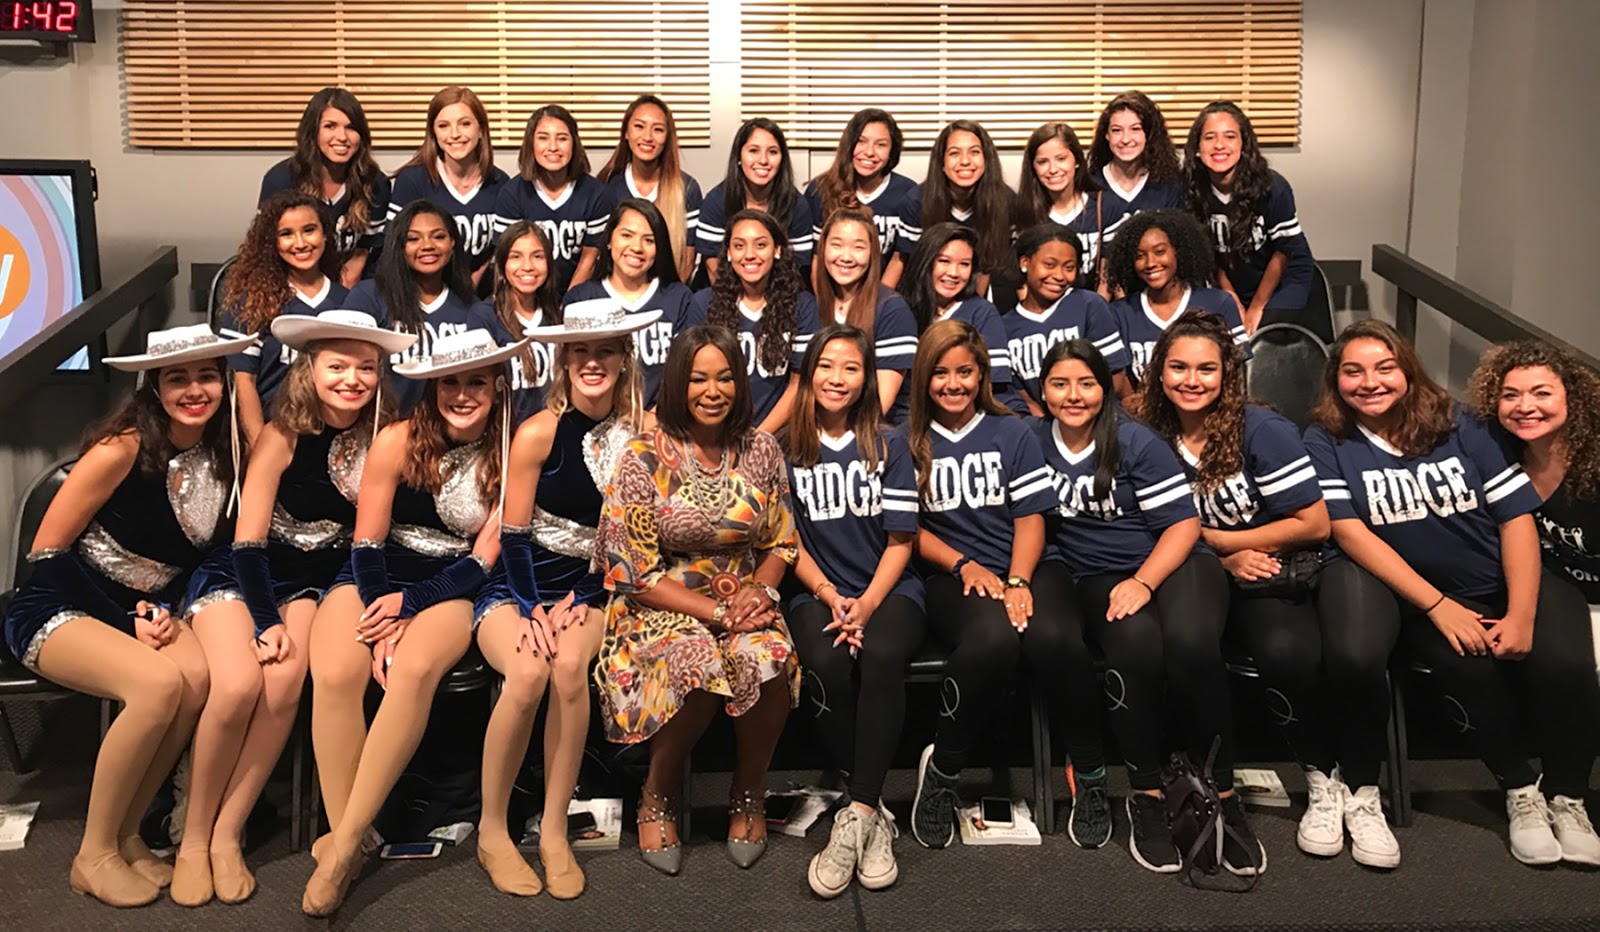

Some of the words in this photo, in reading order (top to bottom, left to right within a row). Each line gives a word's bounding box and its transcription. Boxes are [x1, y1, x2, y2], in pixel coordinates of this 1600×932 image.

[13, 2, 77, 32] 1:42
[914, 451, 1005, 512] IDGE
[1362, 456, 1478, 525] RIDGE
